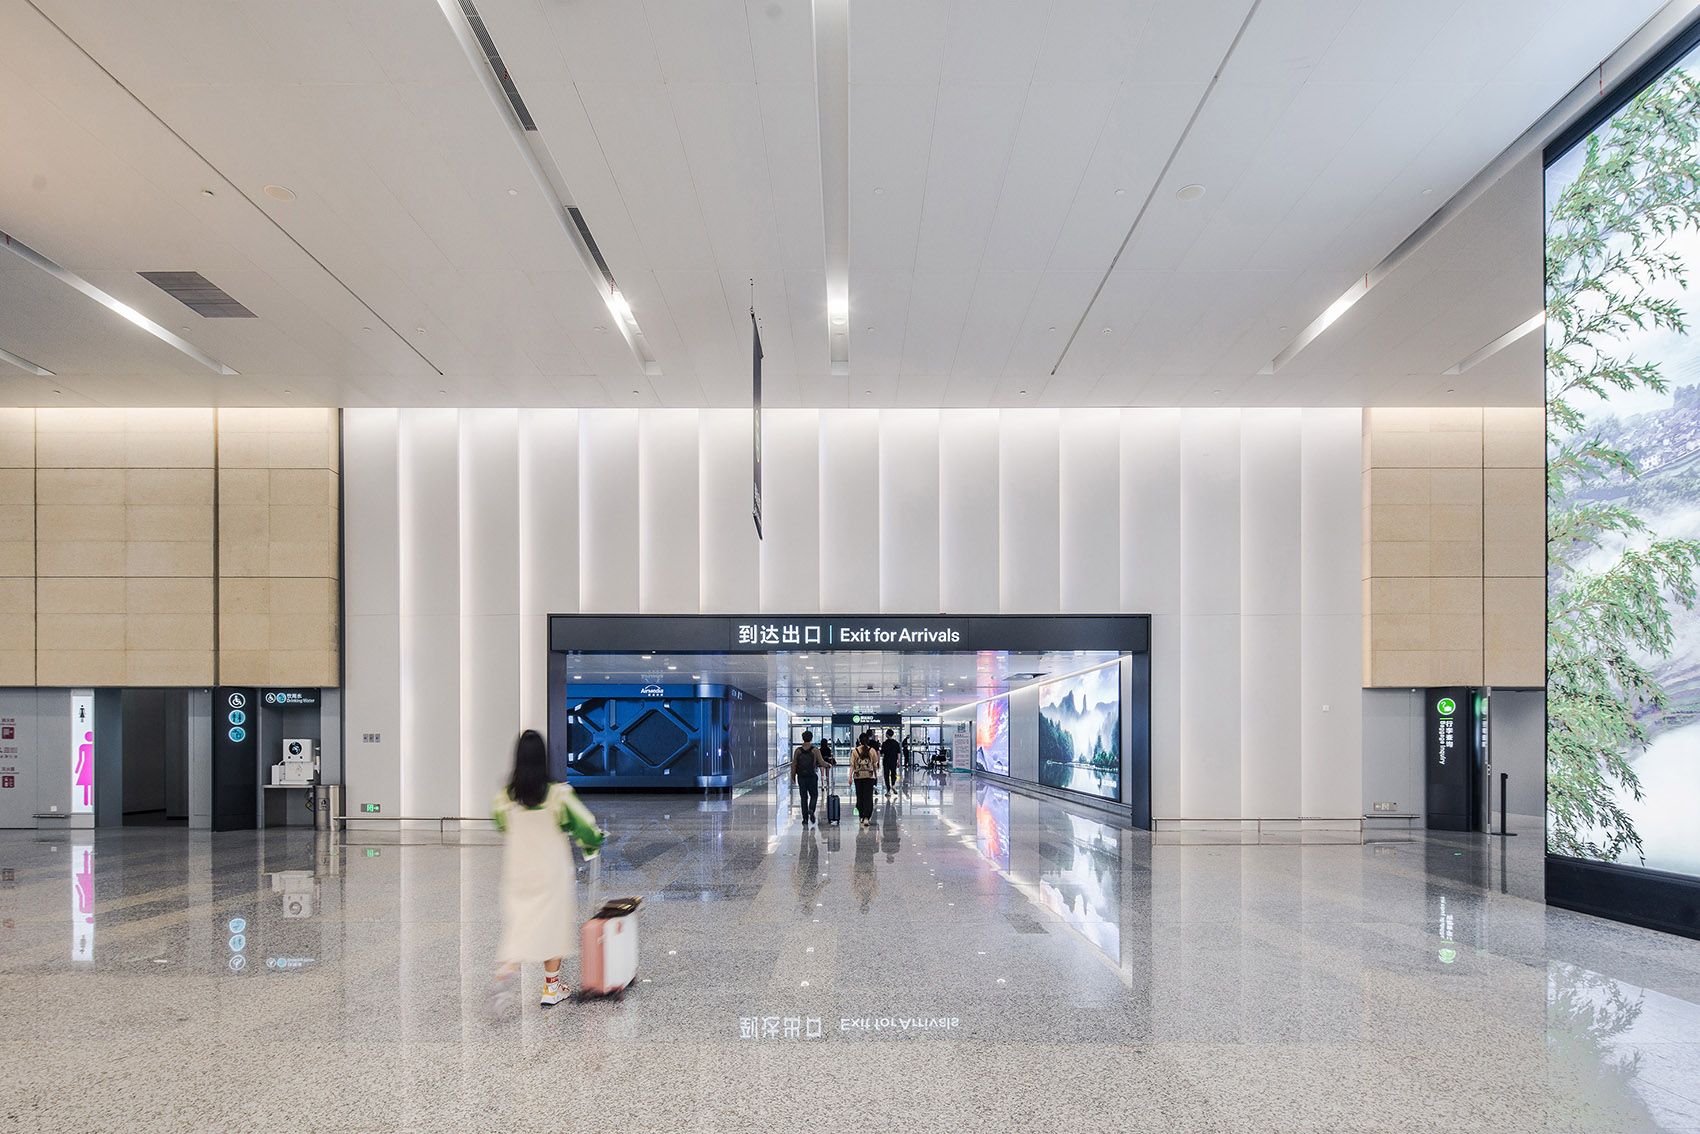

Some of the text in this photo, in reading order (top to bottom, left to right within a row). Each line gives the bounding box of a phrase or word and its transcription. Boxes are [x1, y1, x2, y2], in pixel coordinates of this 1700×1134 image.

[738, 624, 821, 644] 到达出口
[839, 627, 960, 643] Exit for Arrivals
